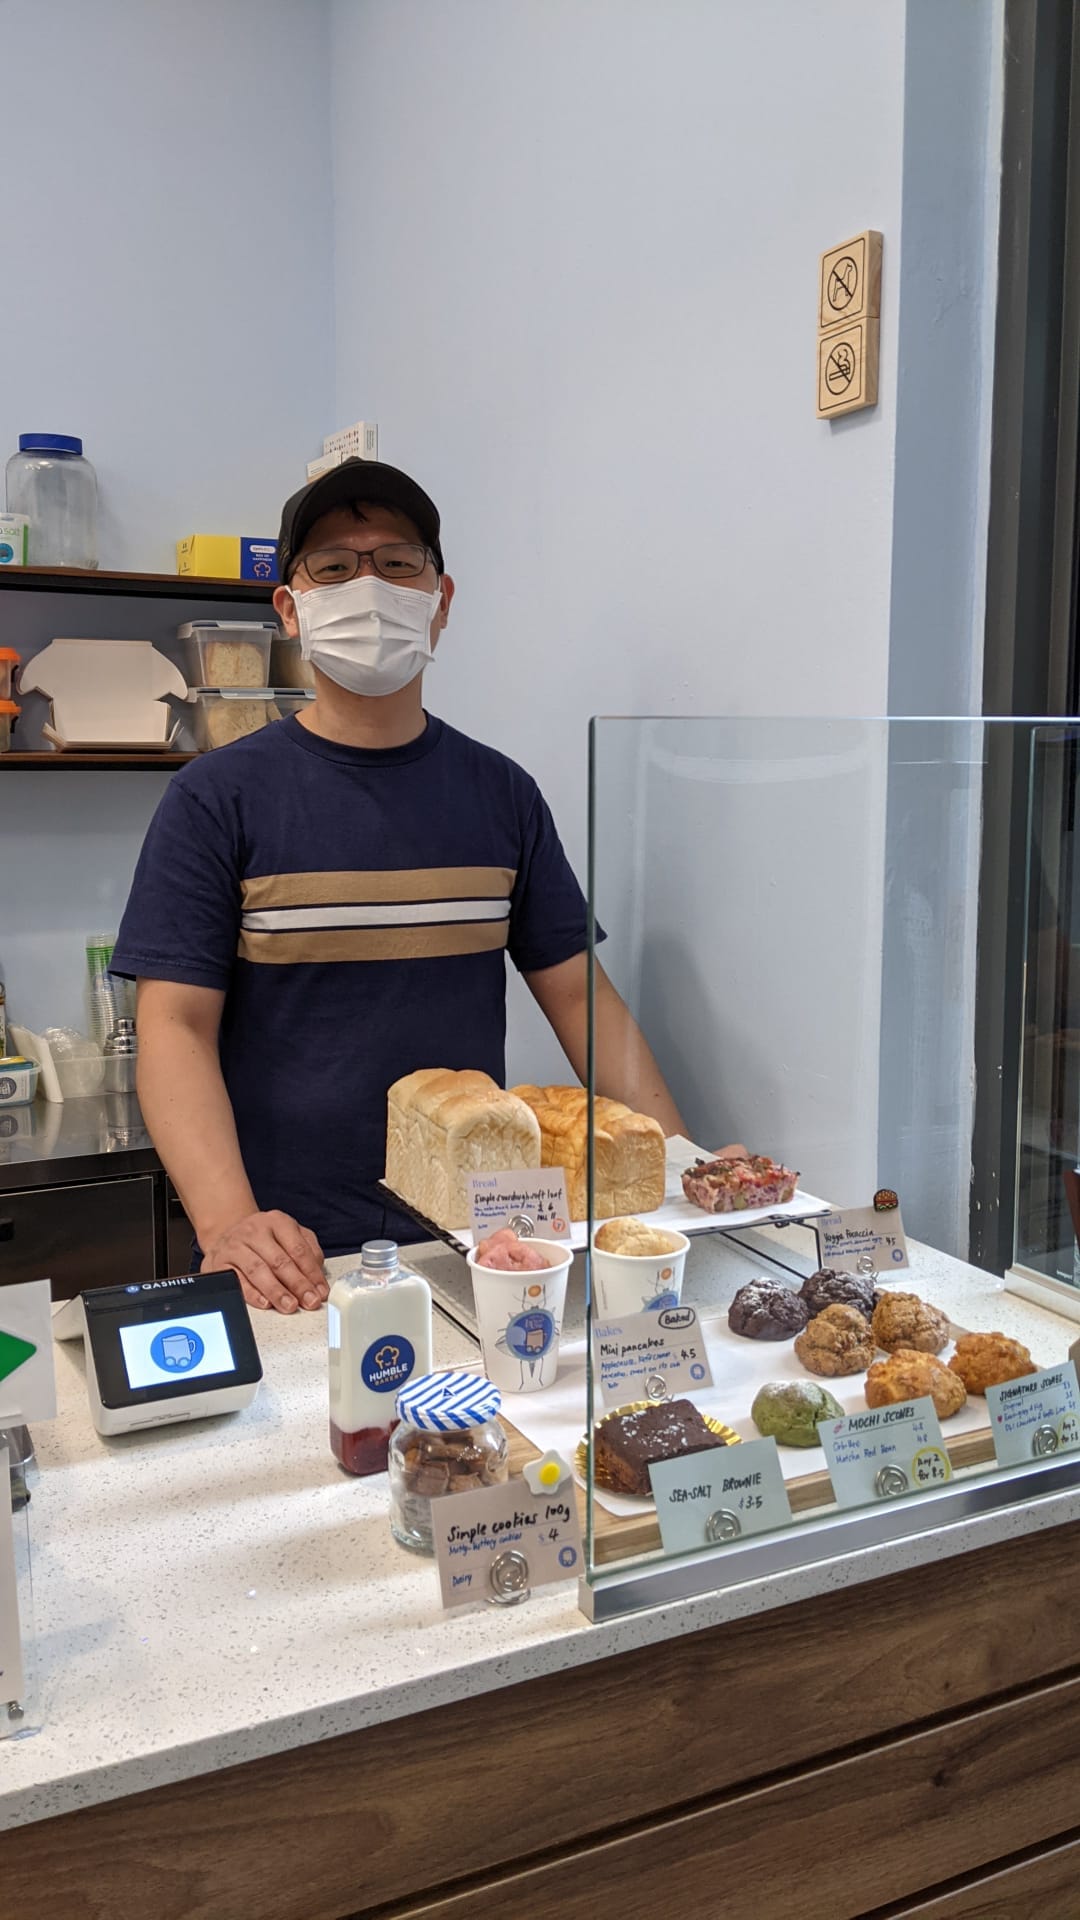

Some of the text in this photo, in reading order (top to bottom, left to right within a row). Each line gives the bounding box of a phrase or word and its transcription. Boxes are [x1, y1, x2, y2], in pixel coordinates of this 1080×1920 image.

[474, 1192, 495, 1205] Simple
[142, 1277, 195, 1290] QASHIER
[595, 1327, 623, 1338] Bakes
[600, 1338, 665, 1358] Mini pancakes
[369, 1362, 408, 1382] HUMBLE
[374, 1373, 403, 1386] BAKERY
[1000, 1374, 1063, 1401] SIGNATURE SCONES
[848, 1407, 914, 1431] MOCHI SCONES
[864, 1446, 876, 1458] Red
[880, 1443, 897, 1455] Bean
[934, 1453, 940, 1461] 2
[669, 1472, 762, 1503] SEA-SALT BROWNIE
[448, 1504, 570, 1544] Simple cookies 100g
[548, 1528, 559, 1541] 4
[452, 1573, 472, 1587] Dairy
